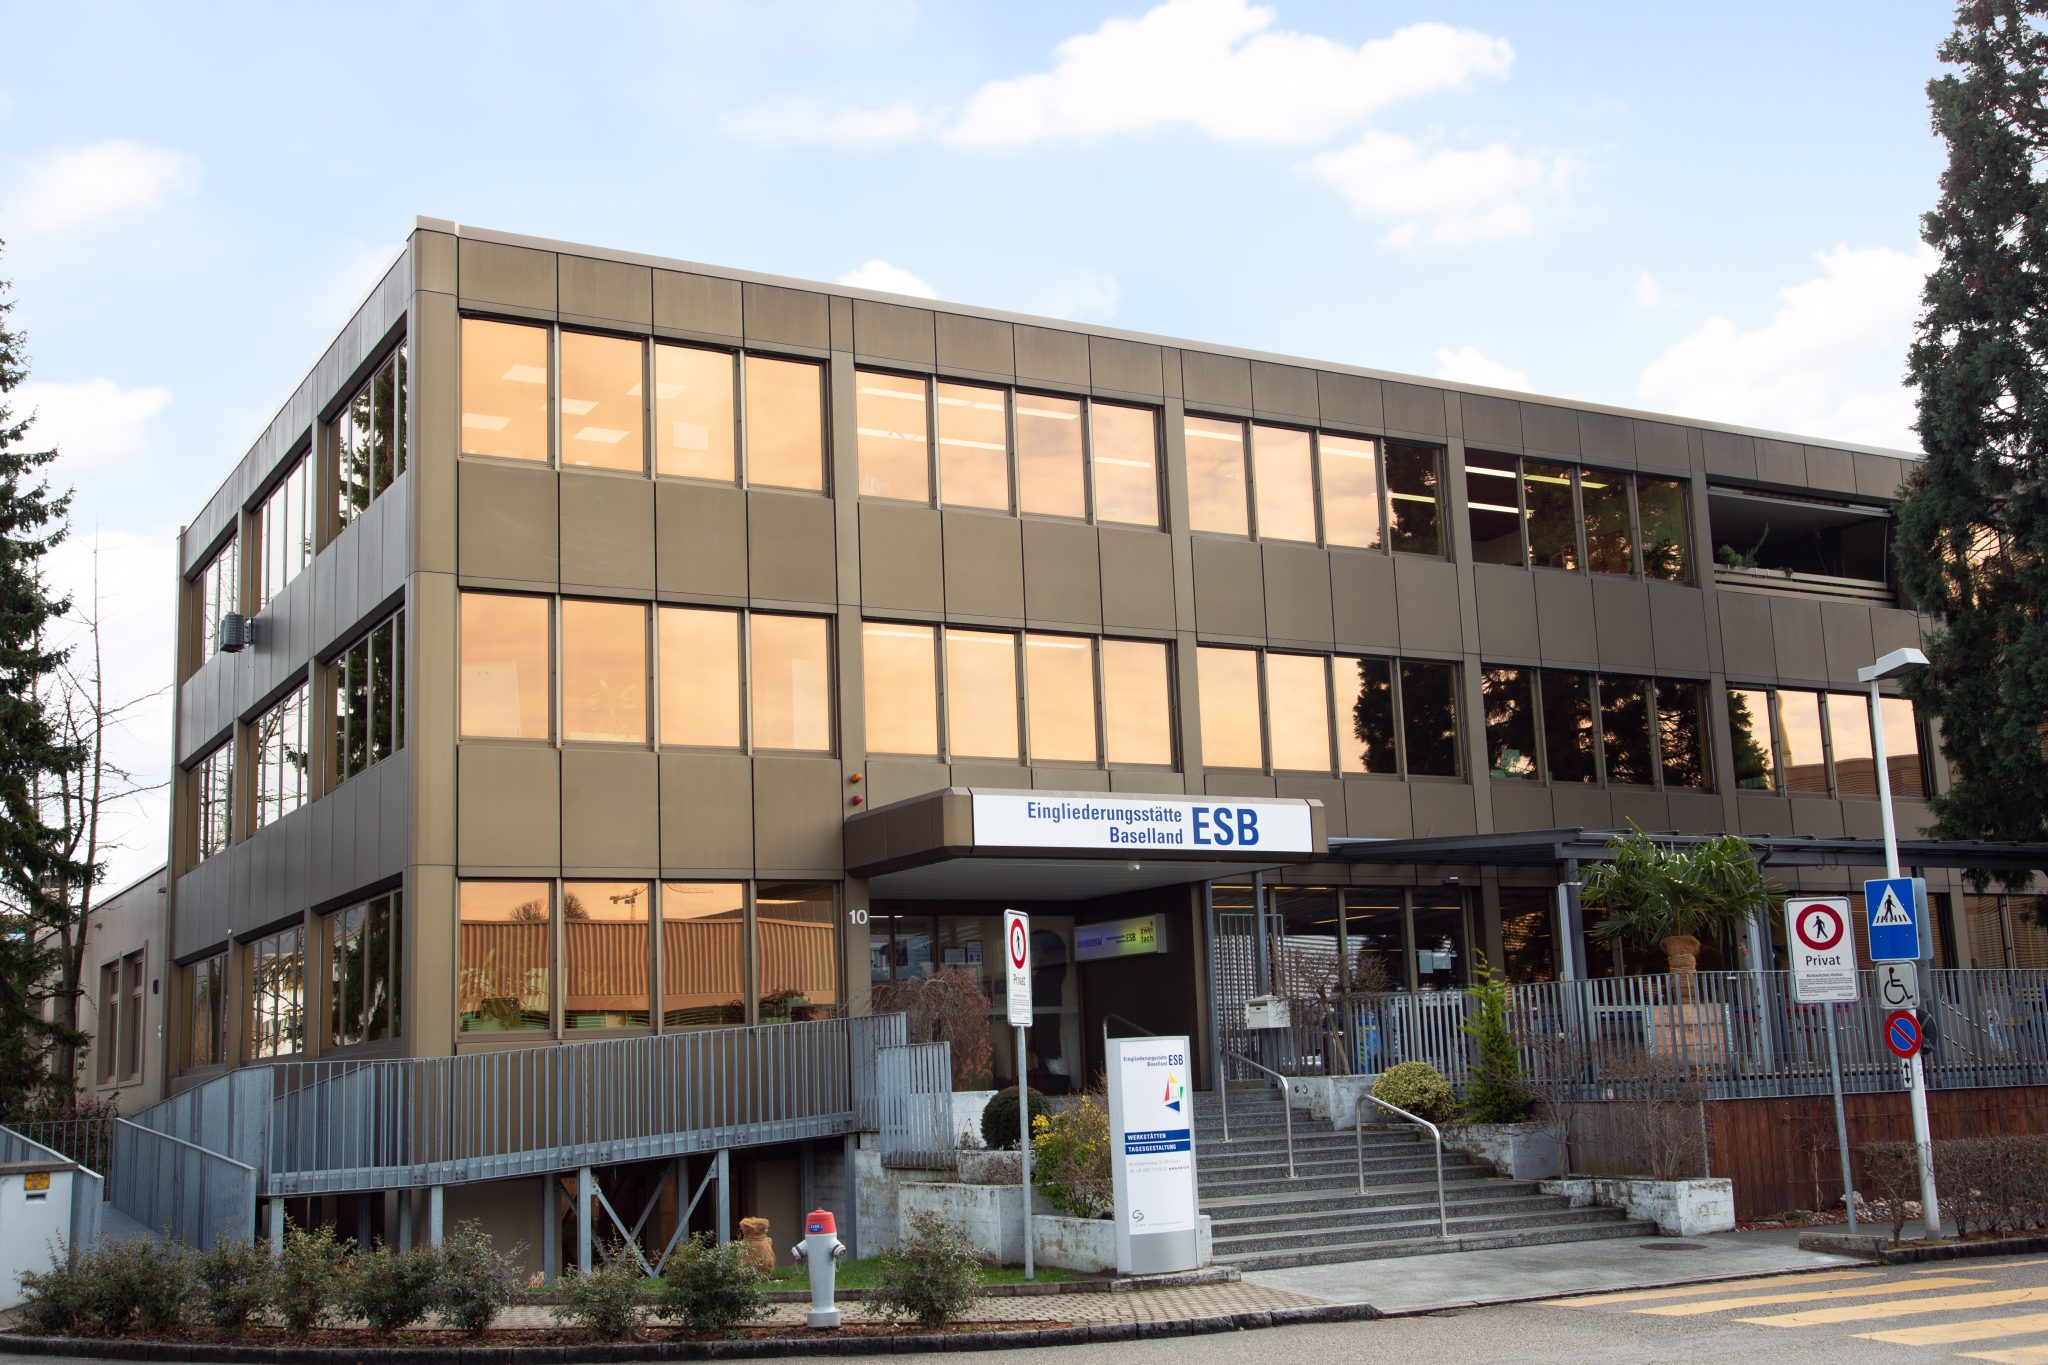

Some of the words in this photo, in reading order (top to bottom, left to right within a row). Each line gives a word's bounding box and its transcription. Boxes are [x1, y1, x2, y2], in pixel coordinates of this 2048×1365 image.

[1027, 801, 1182, 824] Eingliederungsstätte
[1191, 806, 1260, 846] ESB
[1109, 826, 1183, 845] Baselland
[848, 909, 868, 925] 10
[1125, 932, 1136, 943] ESB
[1805, 954, 1841, 966] Privat
[1013, 973, 1026, 986] Privat
[1168, 1054, 1184, 1066] ESB
[1127, 1132, 1167, 1141] WERKSTÄTTEN
[1127, 1143, 1177, 1152] TAGESGESTALTUNG
